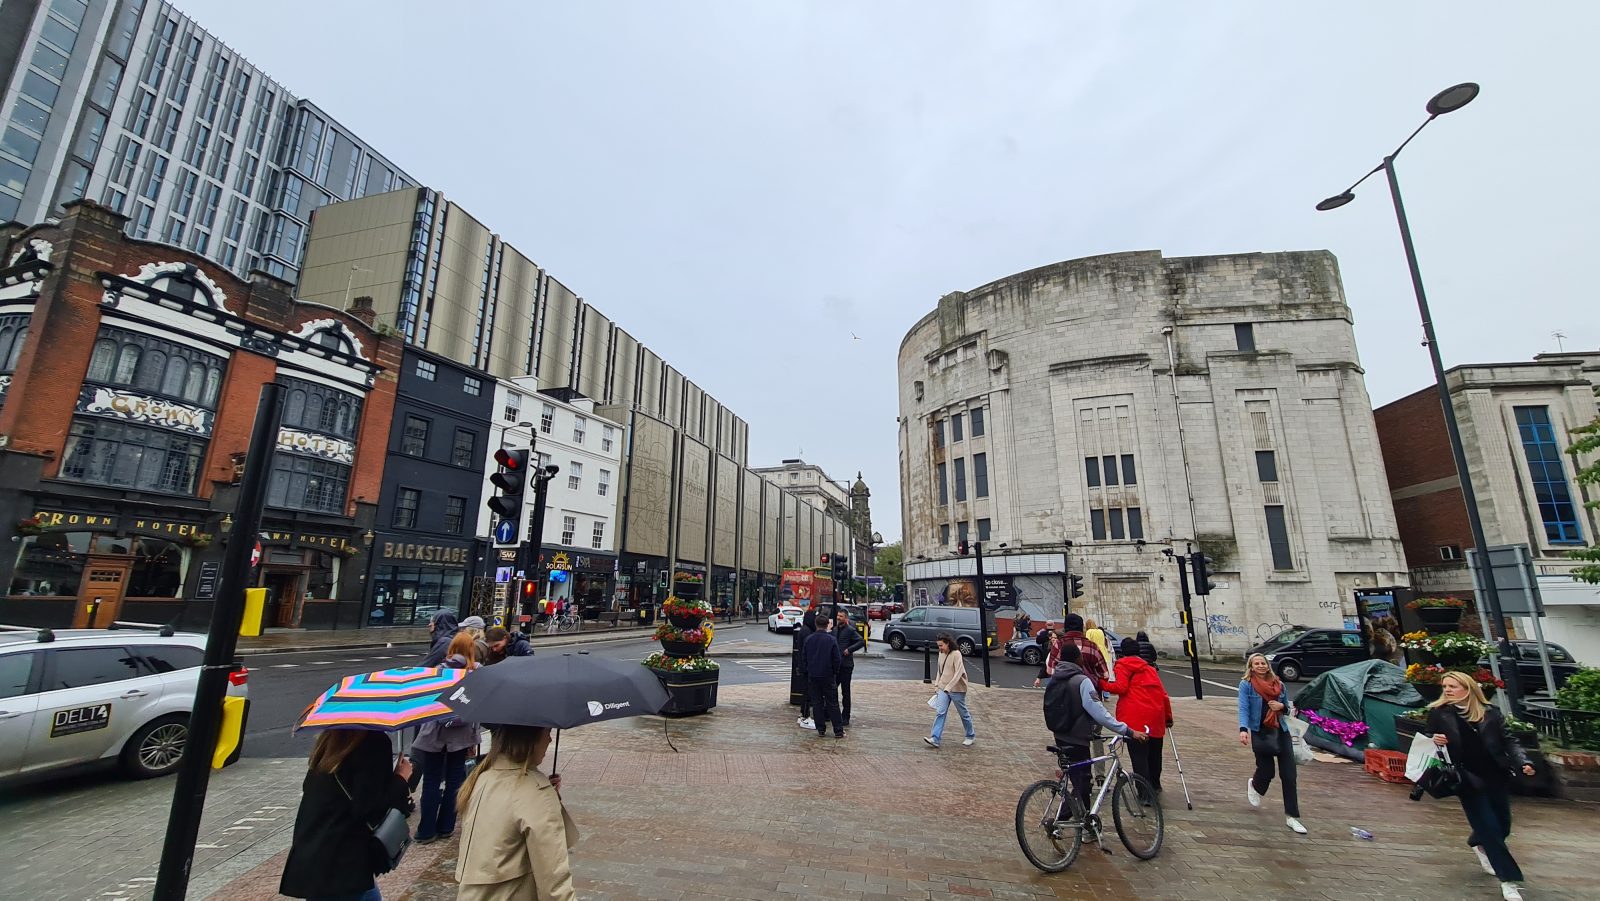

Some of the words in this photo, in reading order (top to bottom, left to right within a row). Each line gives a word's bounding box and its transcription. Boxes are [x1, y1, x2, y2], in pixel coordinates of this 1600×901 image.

[111, 397, 195, 426] CROWN
[281, 432, 347, 455] HOTEL
[35, 511, 112, 526] CROWN
[383, 542, 469, 562] BACKSTAGE
[55, 705, 108, 726] DELTA
[604, 701, 631, 710] Diligent
